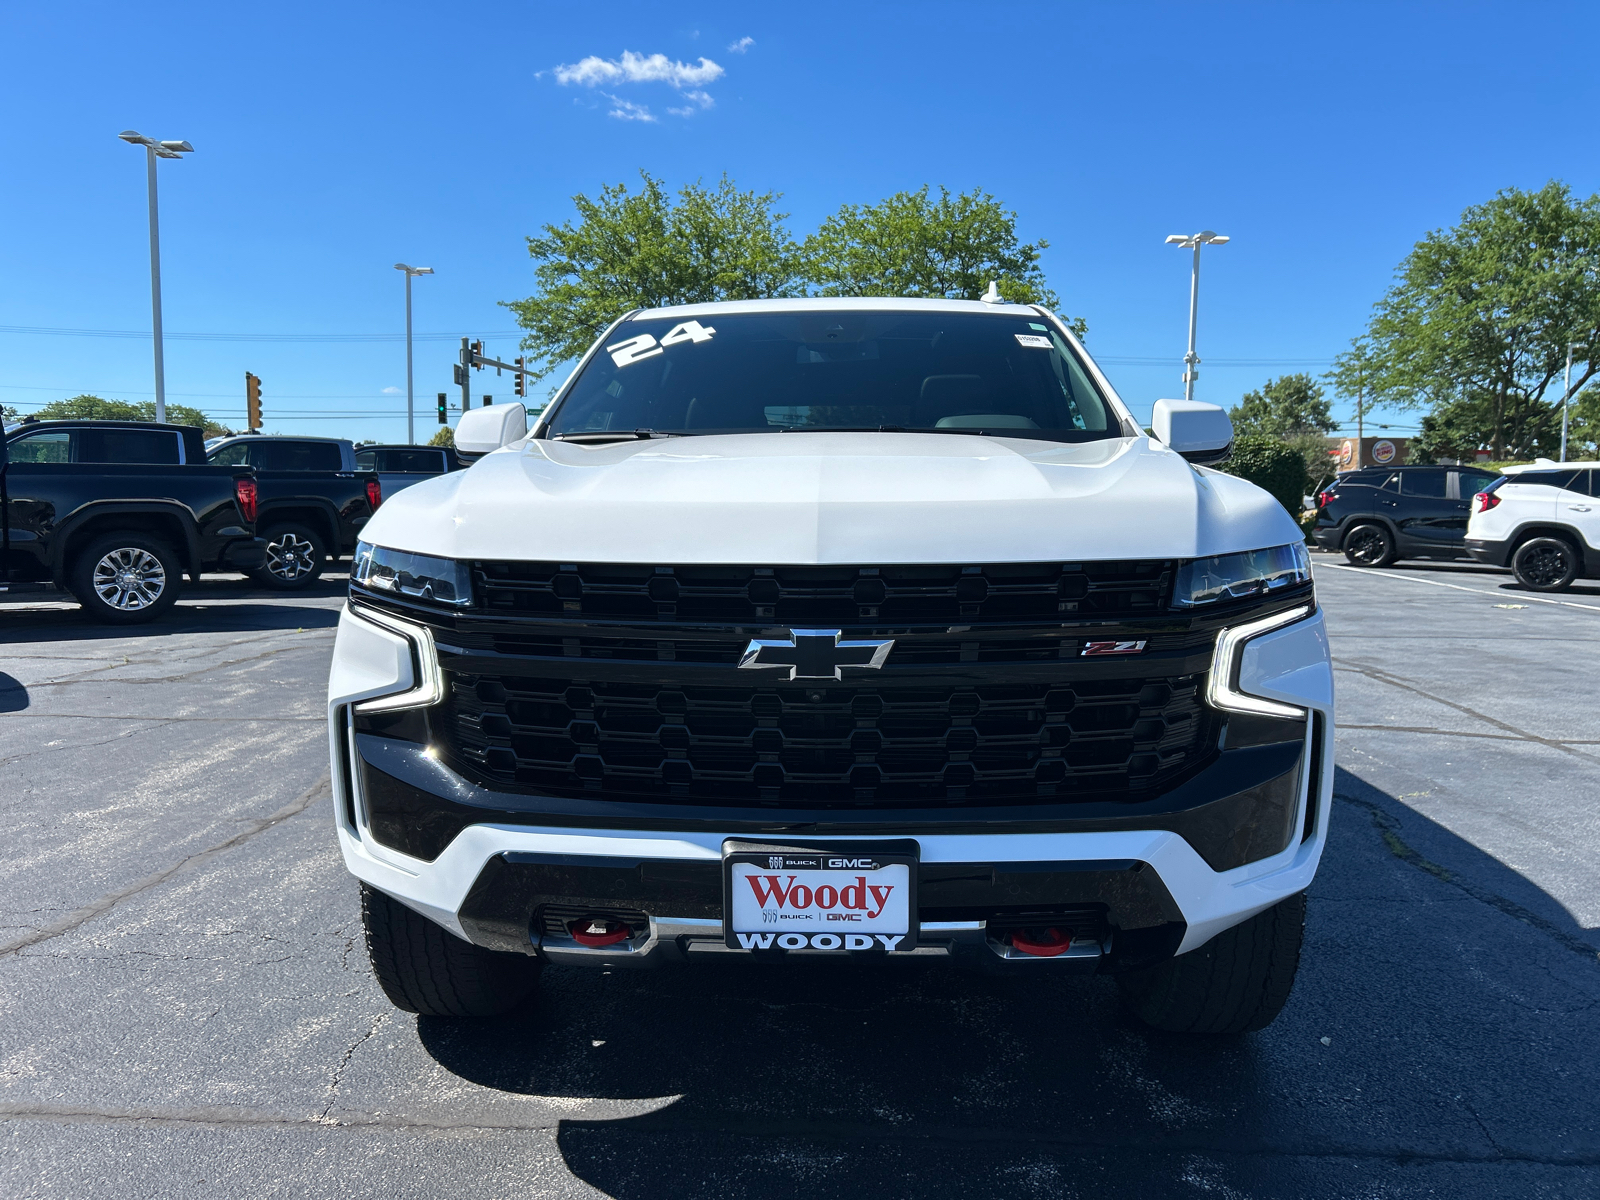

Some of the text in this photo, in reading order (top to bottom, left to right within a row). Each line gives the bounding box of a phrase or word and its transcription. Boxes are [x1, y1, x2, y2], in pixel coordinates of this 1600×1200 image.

[606, 320, 717, 368] 24
[1376, 449, 1393, 458] KING
[1081, 640, 1147, 656] Z71
[828, 858, 872, 868] GMC
[745, 875, 894, 919] Woody
[826, 913, 862, 921] GMC
[736, 933, 906, 951] WOODY
